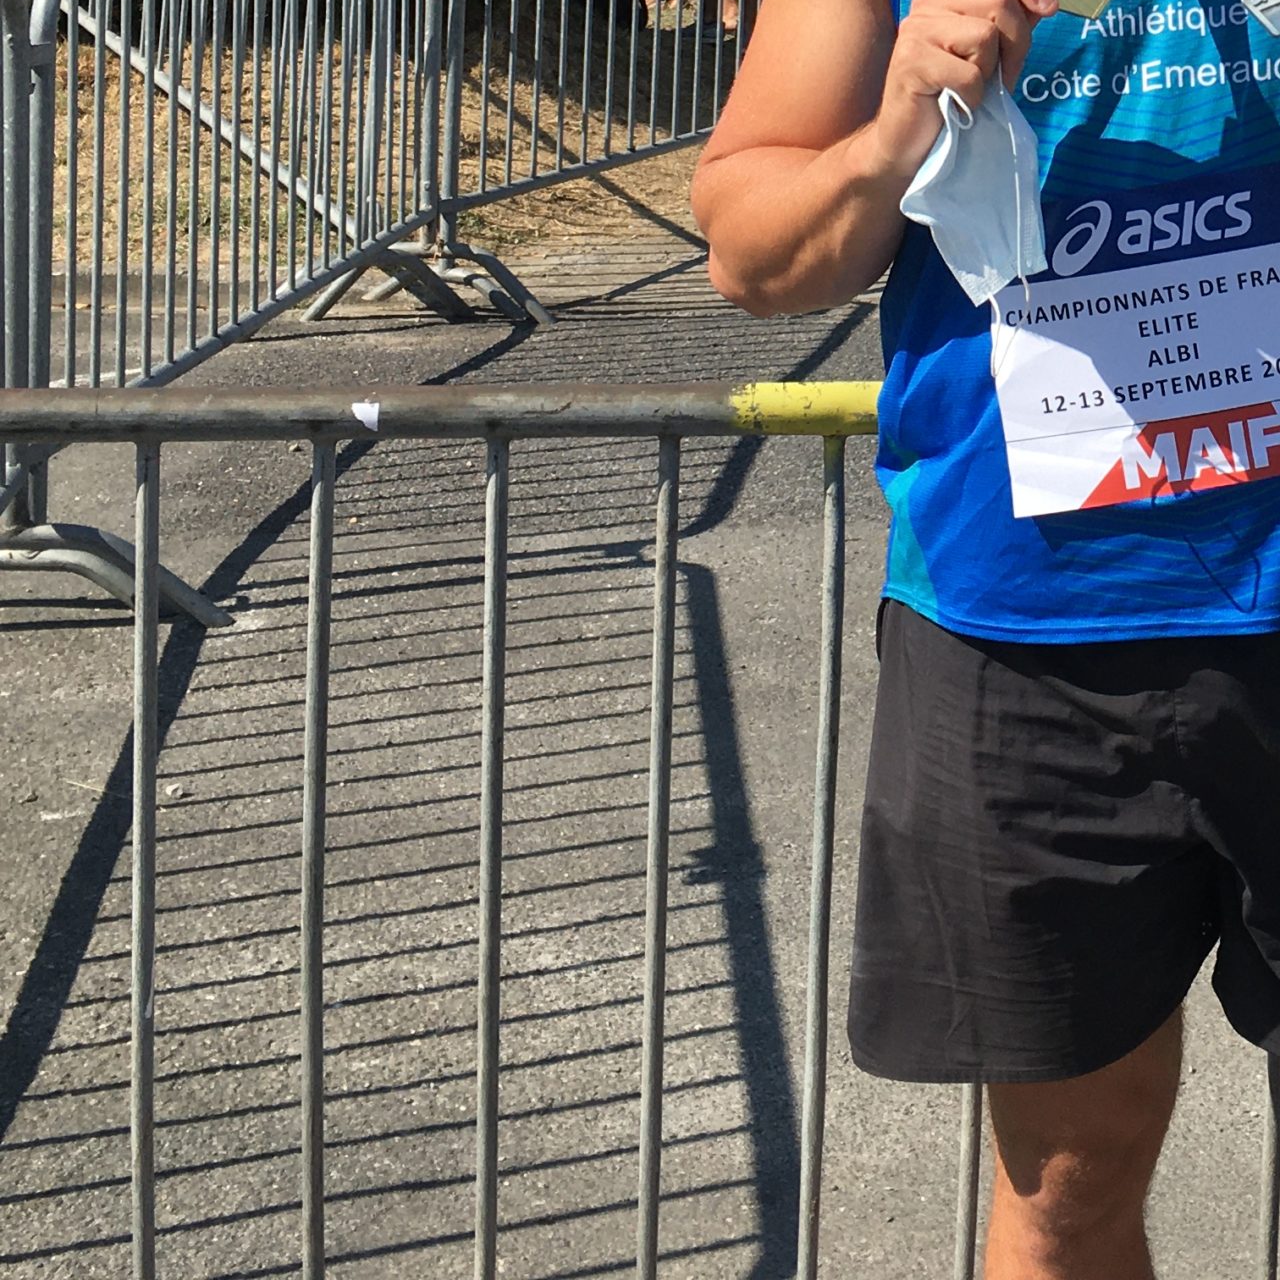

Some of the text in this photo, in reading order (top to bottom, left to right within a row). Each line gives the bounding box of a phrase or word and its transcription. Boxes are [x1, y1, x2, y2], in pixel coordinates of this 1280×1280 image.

[1080, 1, 1249, 40] Athlétique
[1021, 70, 1102, 103] Côte
[1005, 282, 1191, 328] CHAMPIONNATS
[1198, 276, 1229, 298] DE
[1137, 311, 1199, 339] ELITE
[1147, 343, 1200, 369] ALBI
[1040, 389, 1105, 415] 12-13
[1113, 368, 1253, 405] SEPTEMBRE
